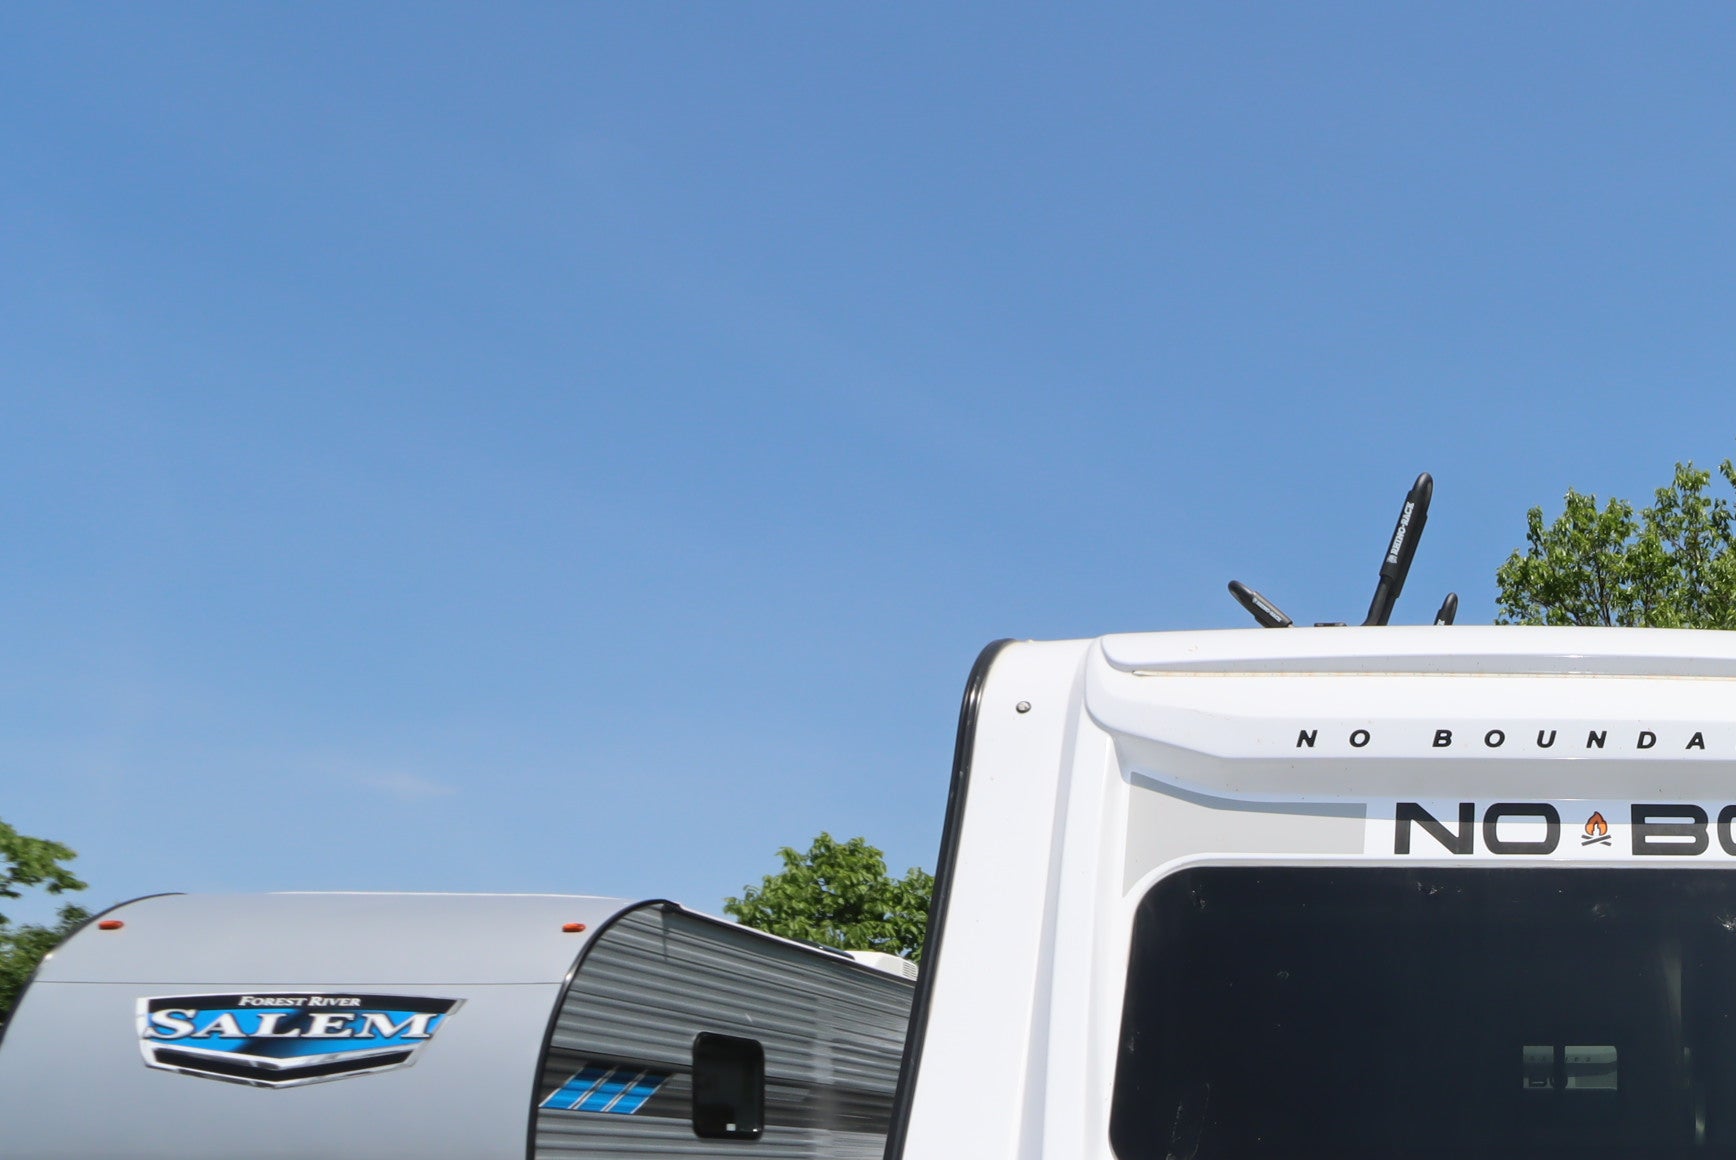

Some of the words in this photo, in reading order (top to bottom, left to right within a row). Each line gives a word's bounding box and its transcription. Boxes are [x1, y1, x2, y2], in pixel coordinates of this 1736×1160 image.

[1390, 501, 1415, 556] RHINO-RACK
[1296, 729, 1371, 748] NO
[237, 995, 307, 1008] FOREST
[307, 995, 361, 1008] RIVER
[142, 1007, 437, 1040] SALEM
